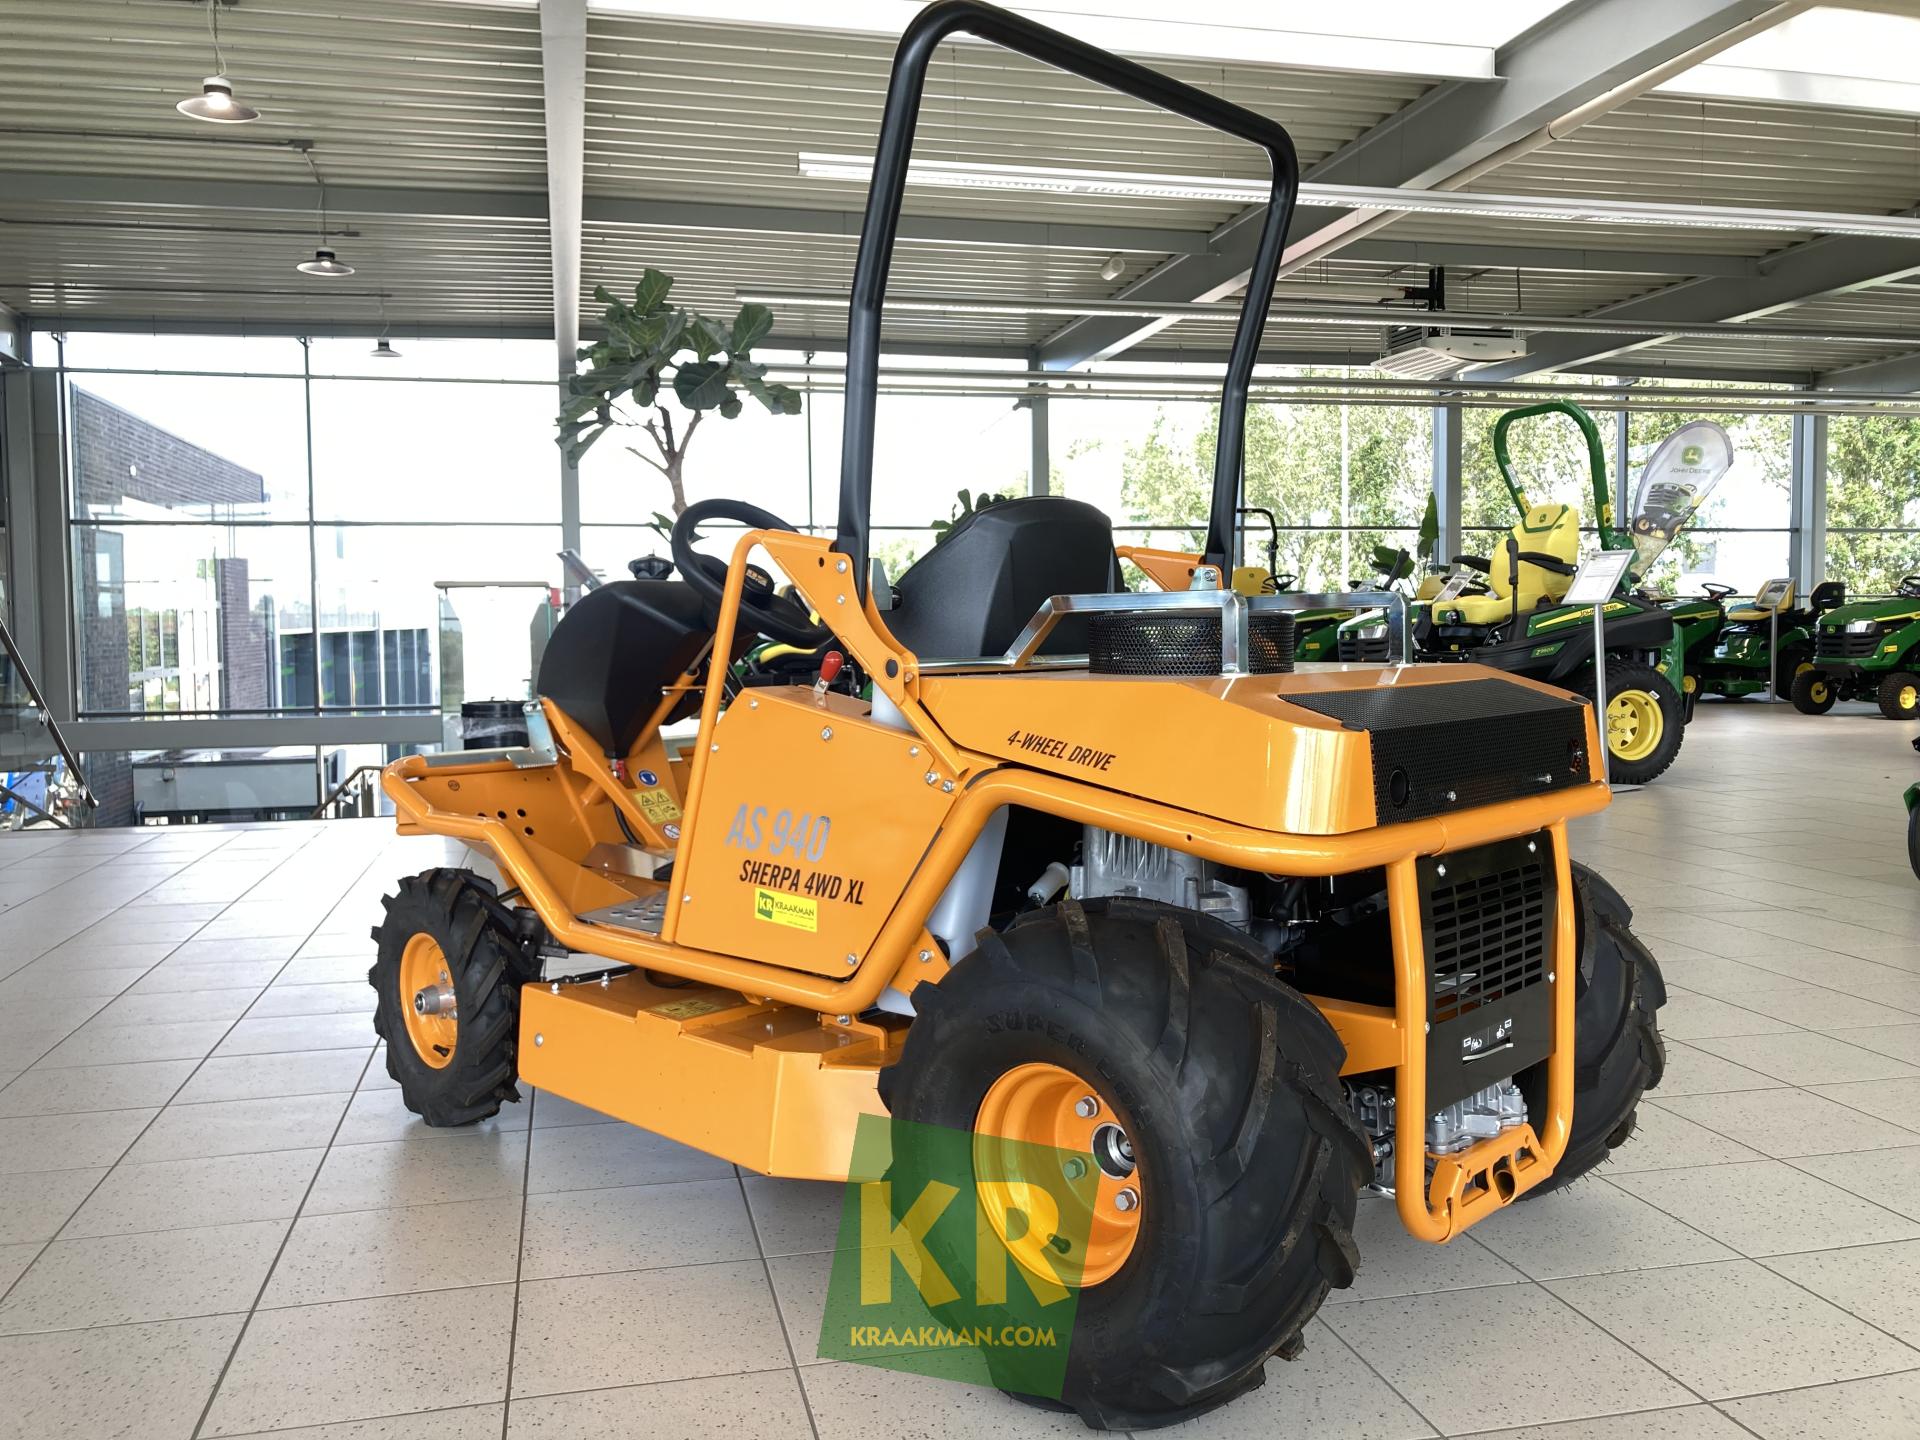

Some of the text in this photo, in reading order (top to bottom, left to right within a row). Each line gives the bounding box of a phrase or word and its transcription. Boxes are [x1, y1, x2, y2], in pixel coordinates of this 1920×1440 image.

[1007, 730, 1117, 771] 4-WHEEL DRIVE
[725, 803, 831, 862] AS 940
[739, 859, 865, 905] SHERPA 4WD XL
[759, 896, 774, 911] KR
[775, 901, 815, 917] KRAAKMAN
[985, 1009, 1087, 1057] SUPER
